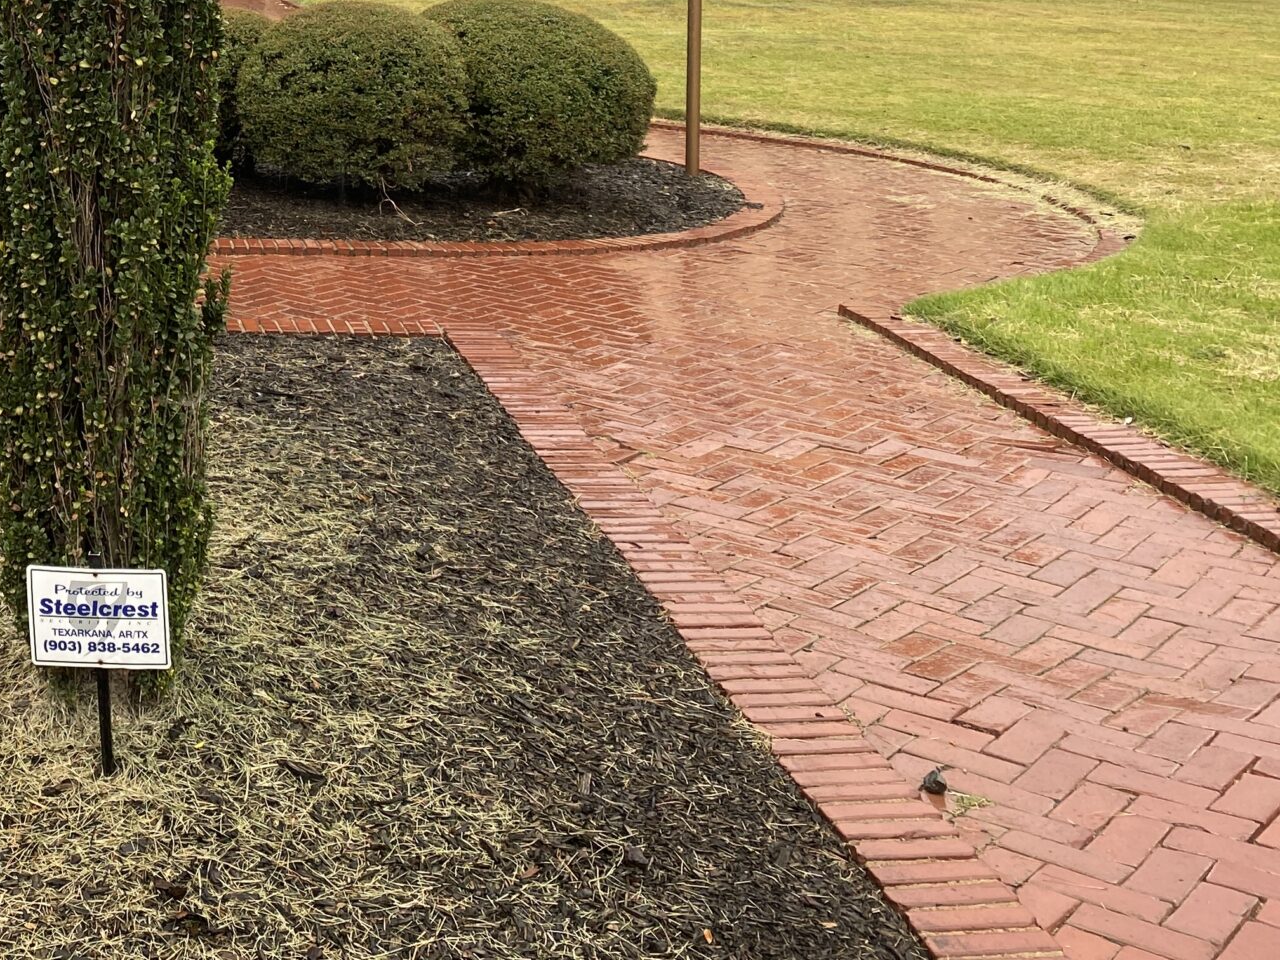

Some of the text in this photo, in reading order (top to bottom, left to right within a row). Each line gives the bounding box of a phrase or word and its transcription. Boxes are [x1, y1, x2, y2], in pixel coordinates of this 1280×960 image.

[54, 584, 143, 598] Protected by
[39, 598, 158, 617] Steelcrest
[52, 628, 148, 638] TEXARKANA, AR/TX
[44, 640, 160, 653] (903) 838-5462
